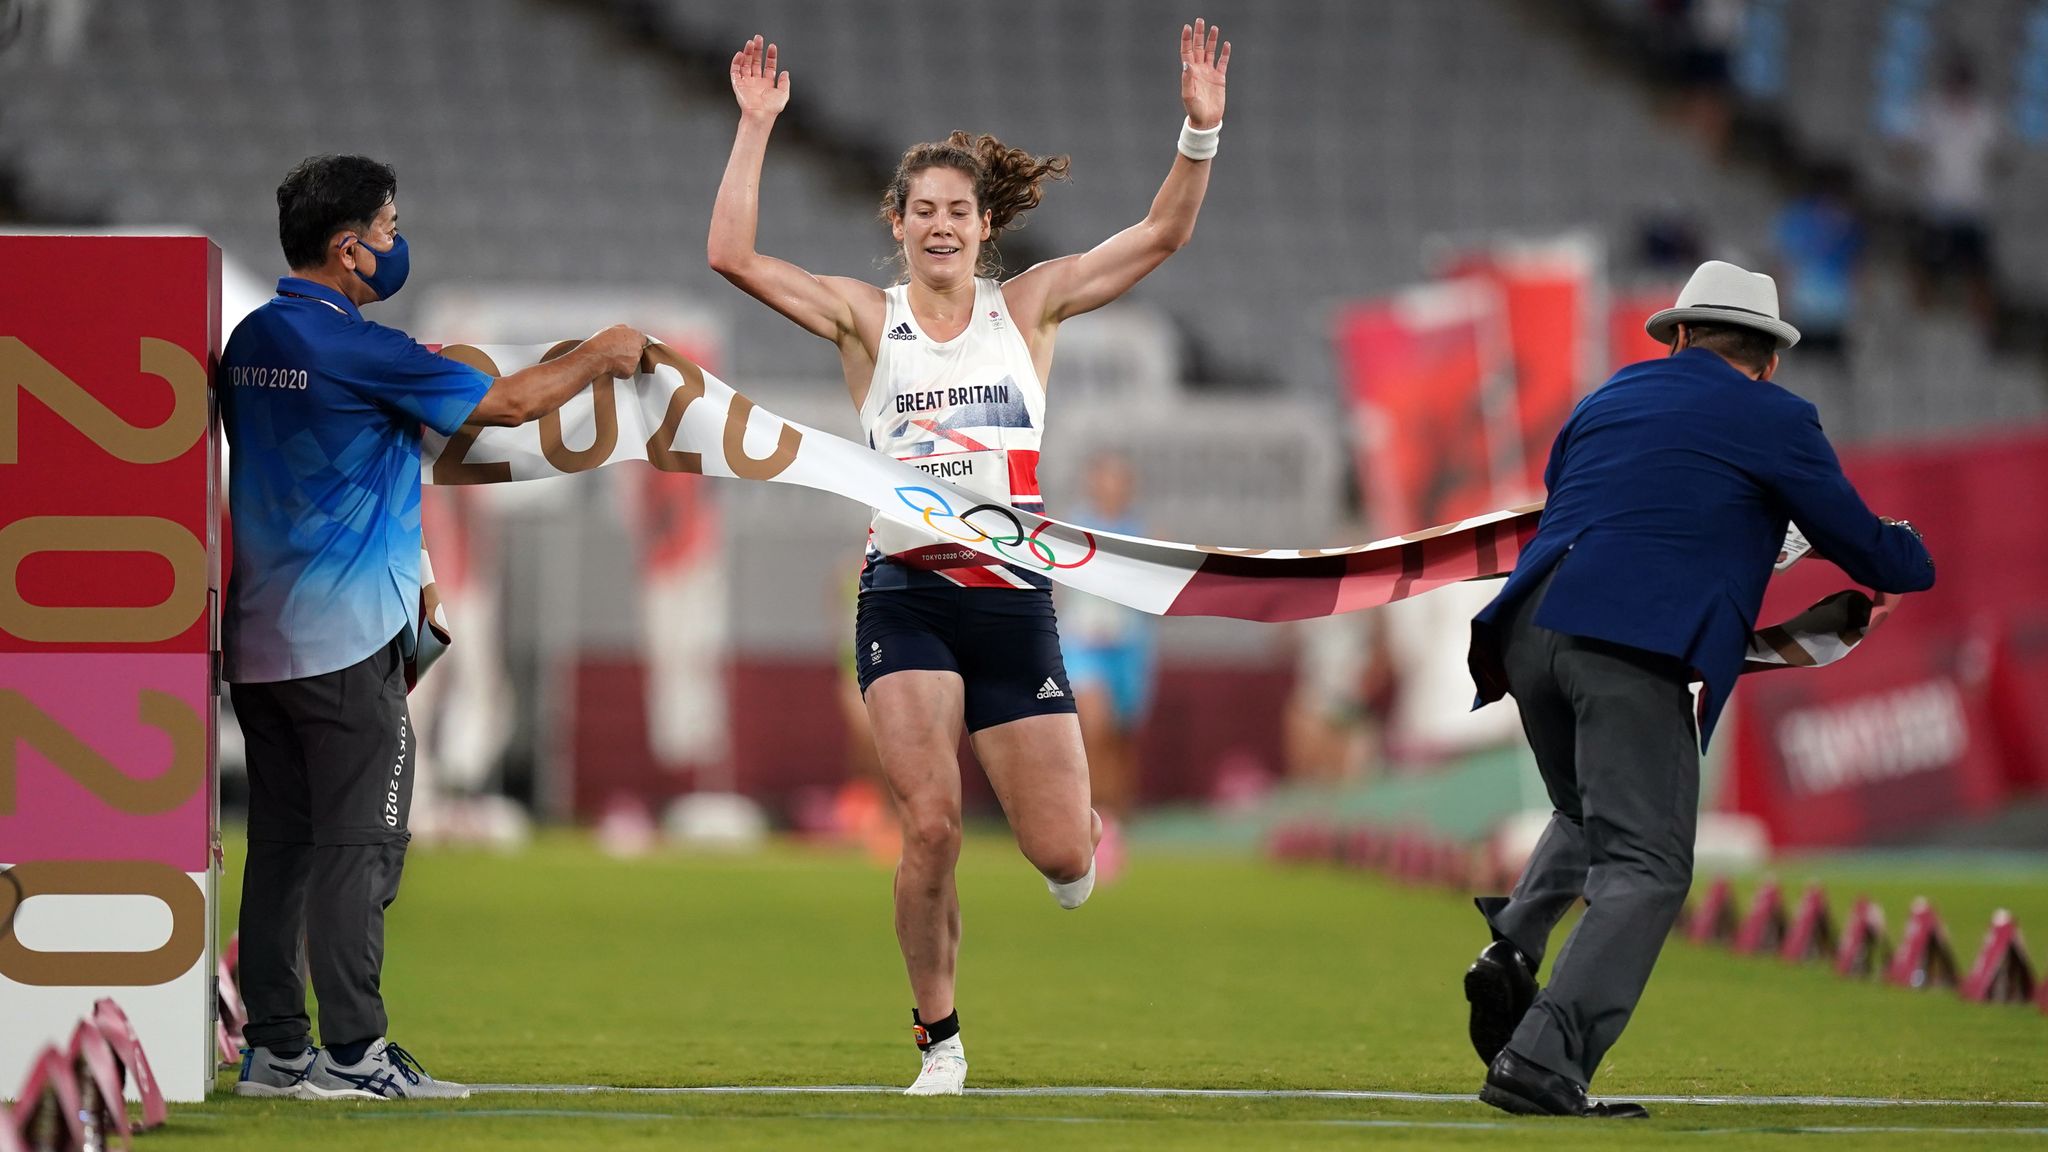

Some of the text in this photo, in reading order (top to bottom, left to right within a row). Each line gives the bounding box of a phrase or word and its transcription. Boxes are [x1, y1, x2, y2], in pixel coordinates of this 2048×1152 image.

[888, 332, 917, 341] adidas
[226, 366, 308, 390] TOKYO 2020
[896, 385, 1009, 414] GREAT BRITAIN
[942, 552, 958, 560] 2020
[1036, 689, 1064, 699] adidas
[385, 714, 407, 827] TOKYO 2020
